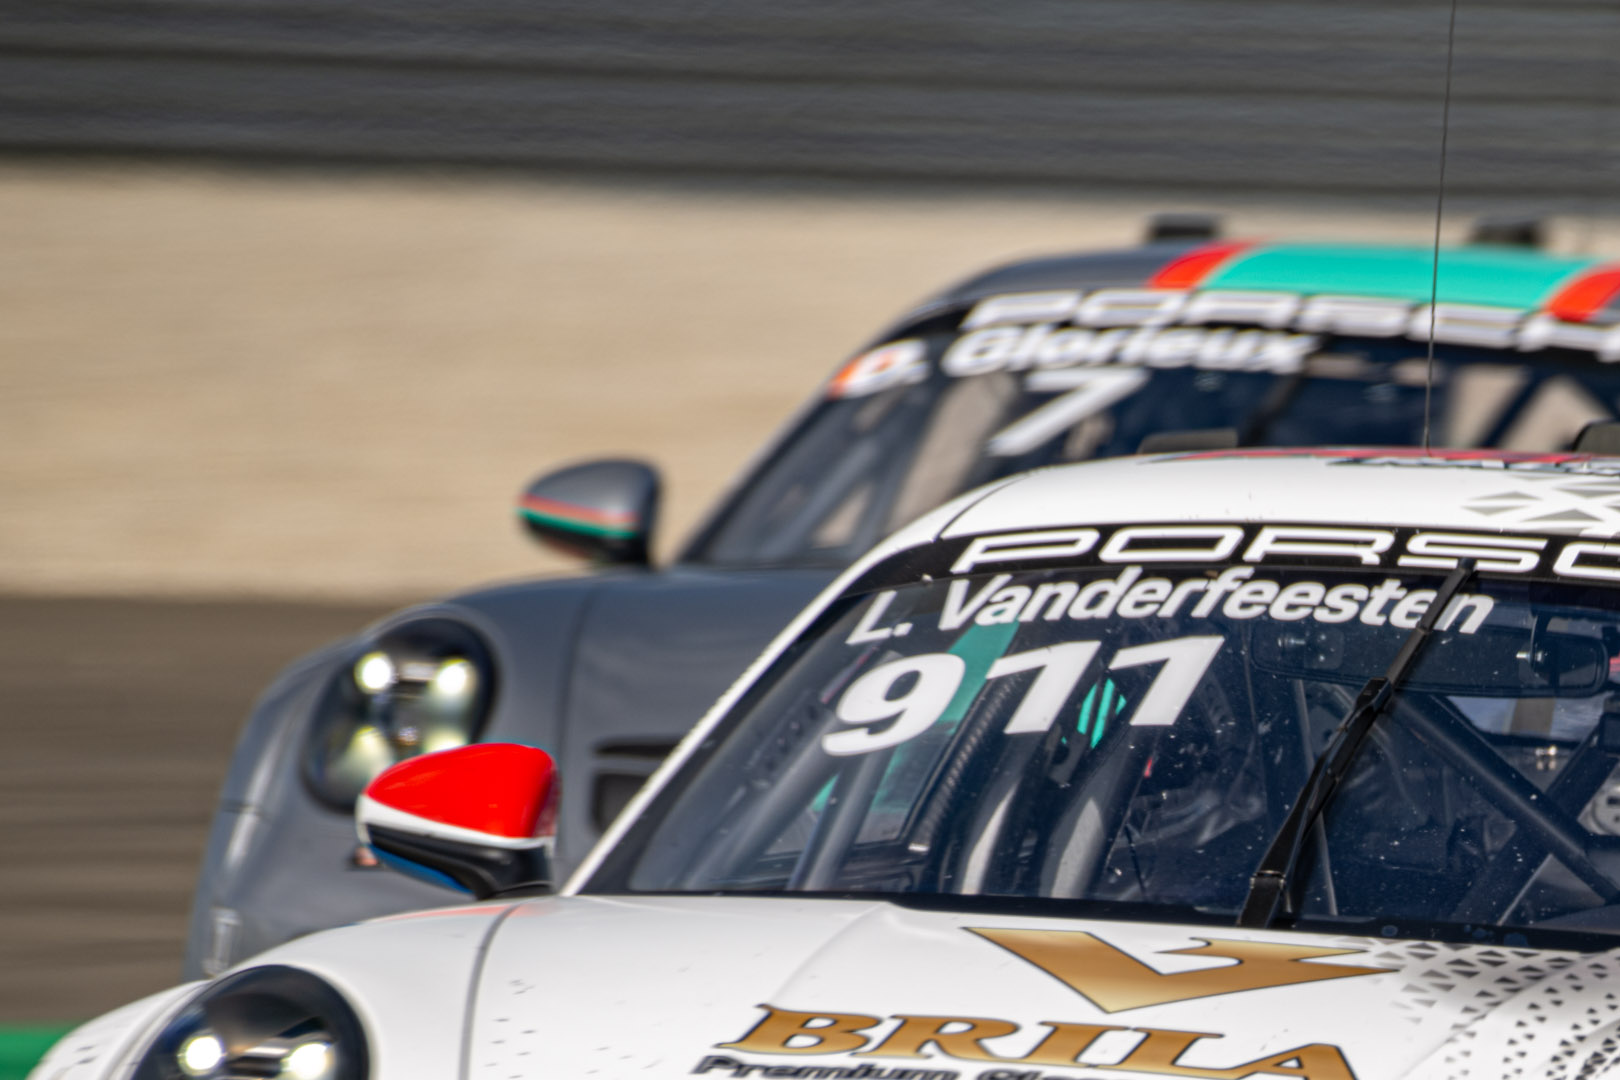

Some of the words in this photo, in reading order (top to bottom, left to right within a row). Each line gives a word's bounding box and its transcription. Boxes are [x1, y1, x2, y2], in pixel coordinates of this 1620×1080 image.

[941, 323, 1318, 376] Glorieux
[988, 366, 1150, 456] 7
[845, 590, 914, 646] L.
[937, 565, 1495, 634] Vanderfeesten
[820, 635, 1226, 757] 911
